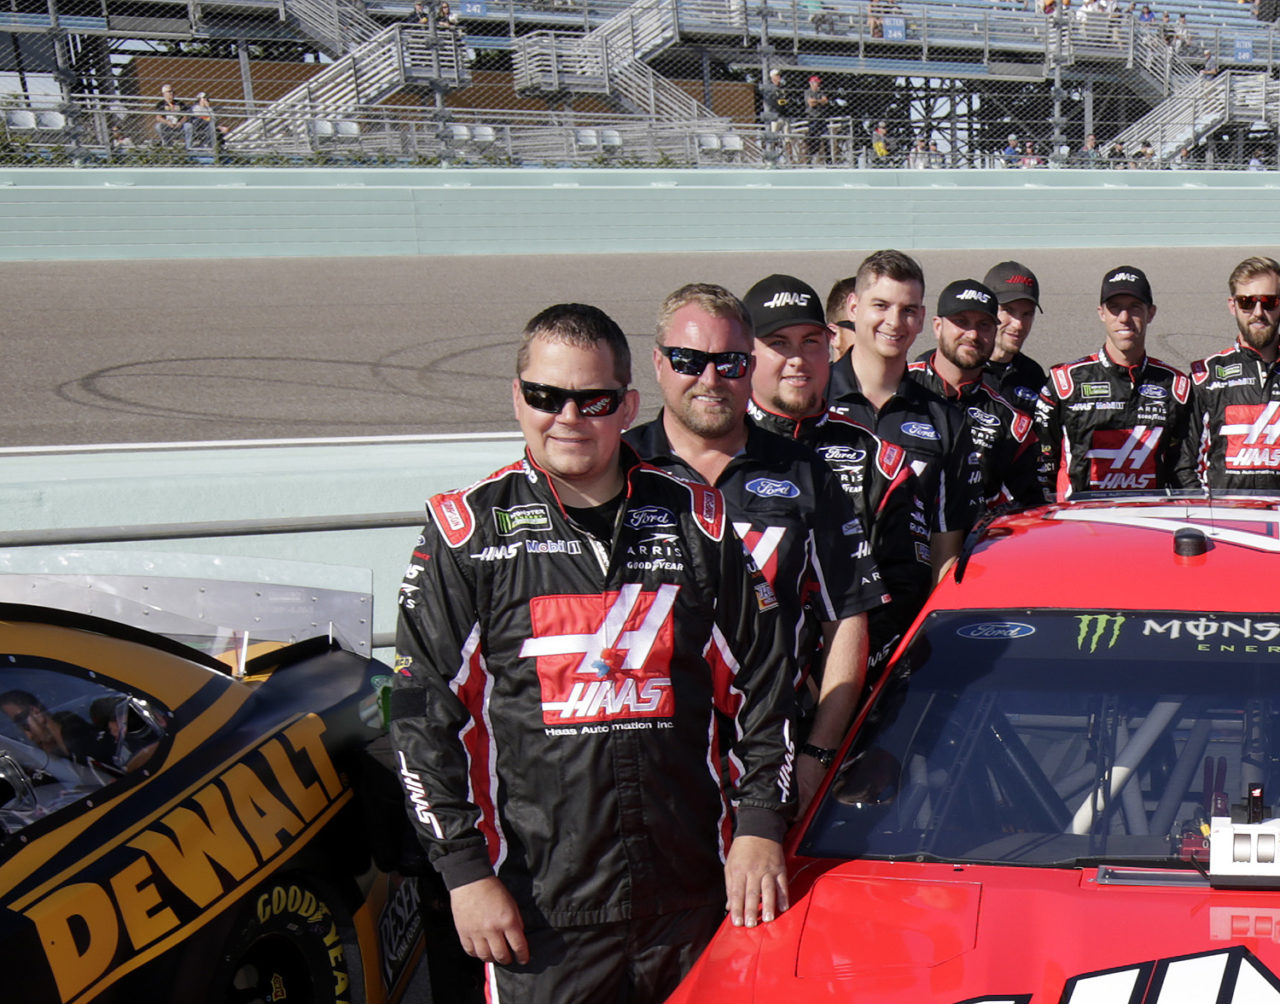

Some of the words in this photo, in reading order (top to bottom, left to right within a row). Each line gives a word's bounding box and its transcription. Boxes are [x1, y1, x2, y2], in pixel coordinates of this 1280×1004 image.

[763, 291, 811, 308] HAAS
[955, 289, 991, 304] HAAS
[905, 423, 938, 438] Ford
[823, 447, 860, 461] Ford
[754, 480, 793, 497] Ford
[1090, 473, 1155, 489] HAAS
[626, 507, 673, 528] Ford
[470, 541, 522, 561] HAAS
[526, 539, 566, 553] Mobil
[627, 545, 682, 557] ARRIS
[626, 558, 684, 572] GOODYEAR
[965, 623, 1023, 638] Ford
[541, 677, 671, 719] HAAS
[545, 726, 577, 737] Haas
